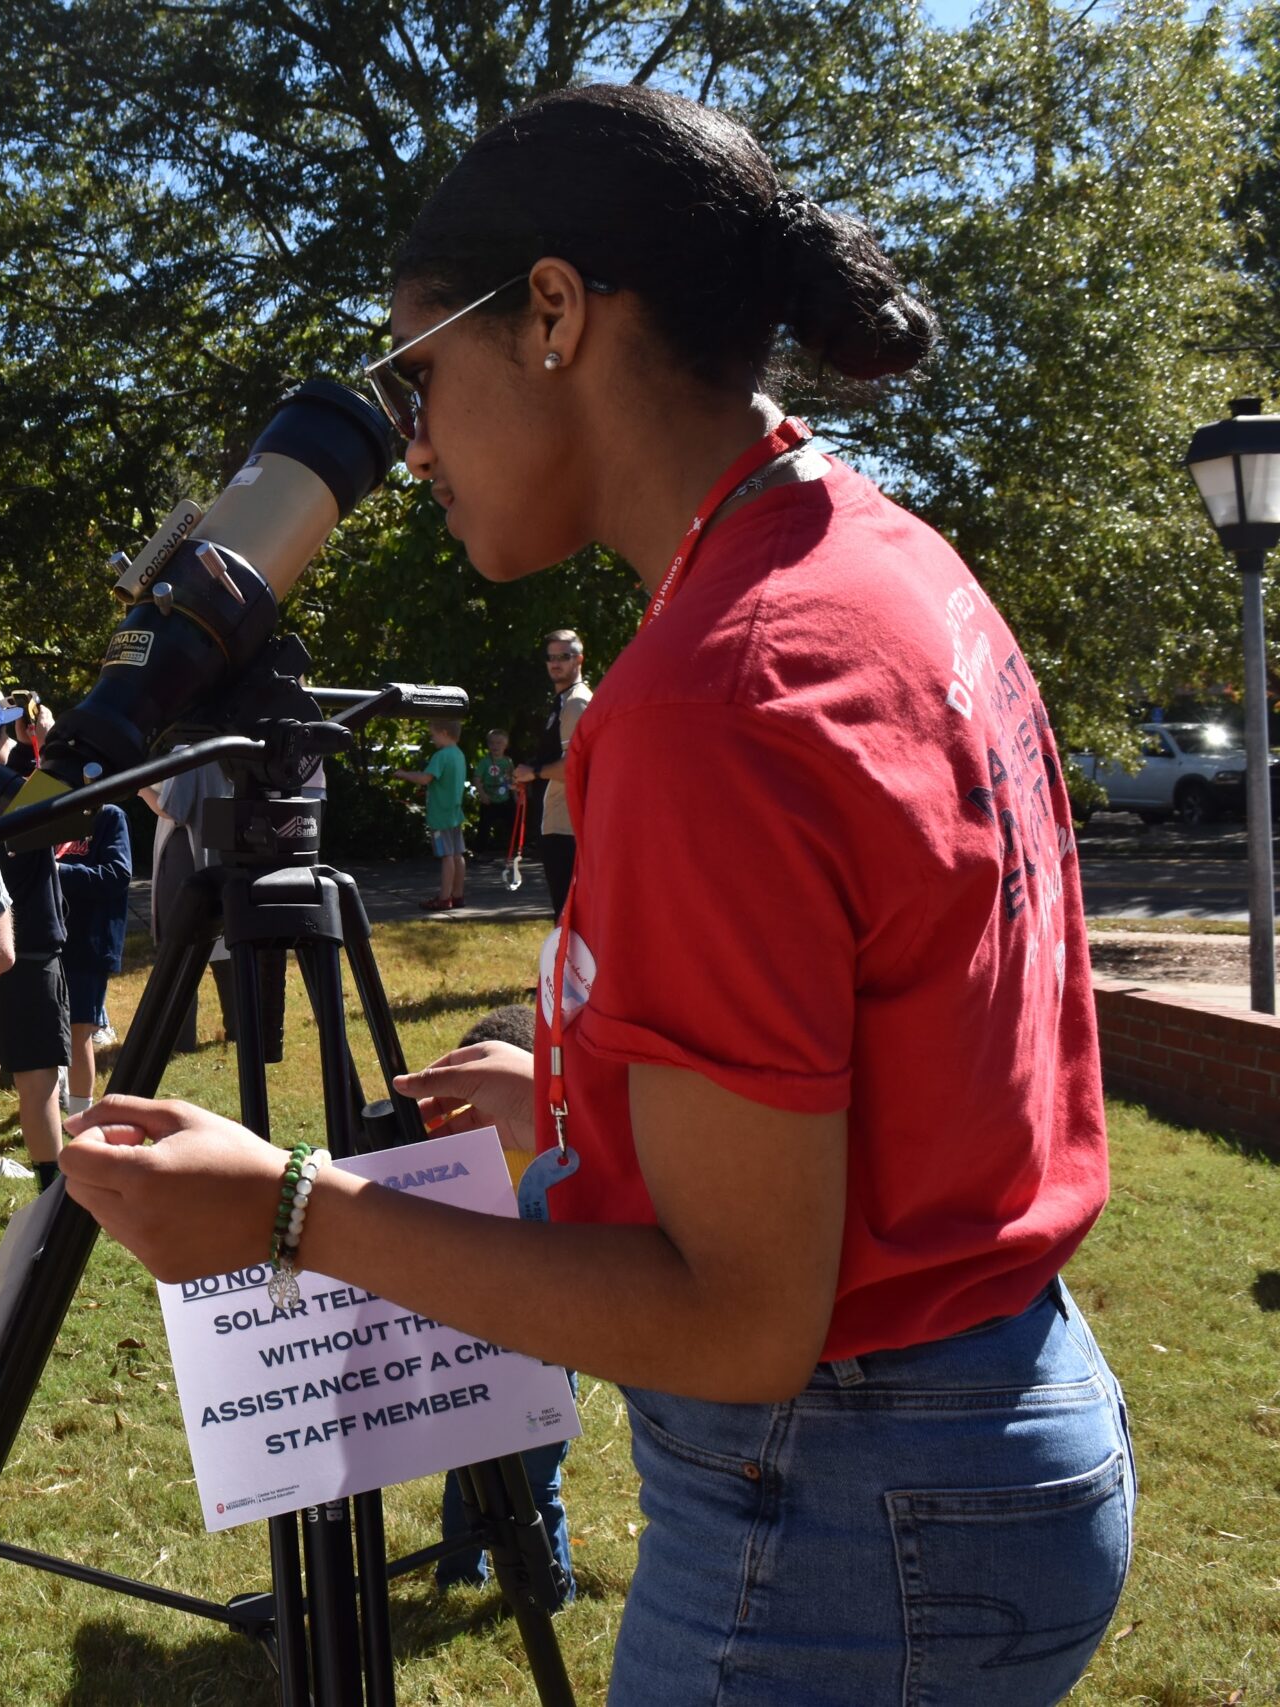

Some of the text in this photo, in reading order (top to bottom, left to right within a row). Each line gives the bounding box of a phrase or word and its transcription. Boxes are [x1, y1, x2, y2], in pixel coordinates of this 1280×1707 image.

[138, 512, 195, 587] CORONADO
[659, 556, 683, 597] Center
[181, 1273, 221, 1299] DO
[213, 1301, 309, 1335] SOLAR
[258, 1315, 447, 1368] WITHOUT TH
[200, 1341, 515, 1428] ASSISTANCE OF A CM
[265, 1382, 491, 1455] STAFF MEMBER
